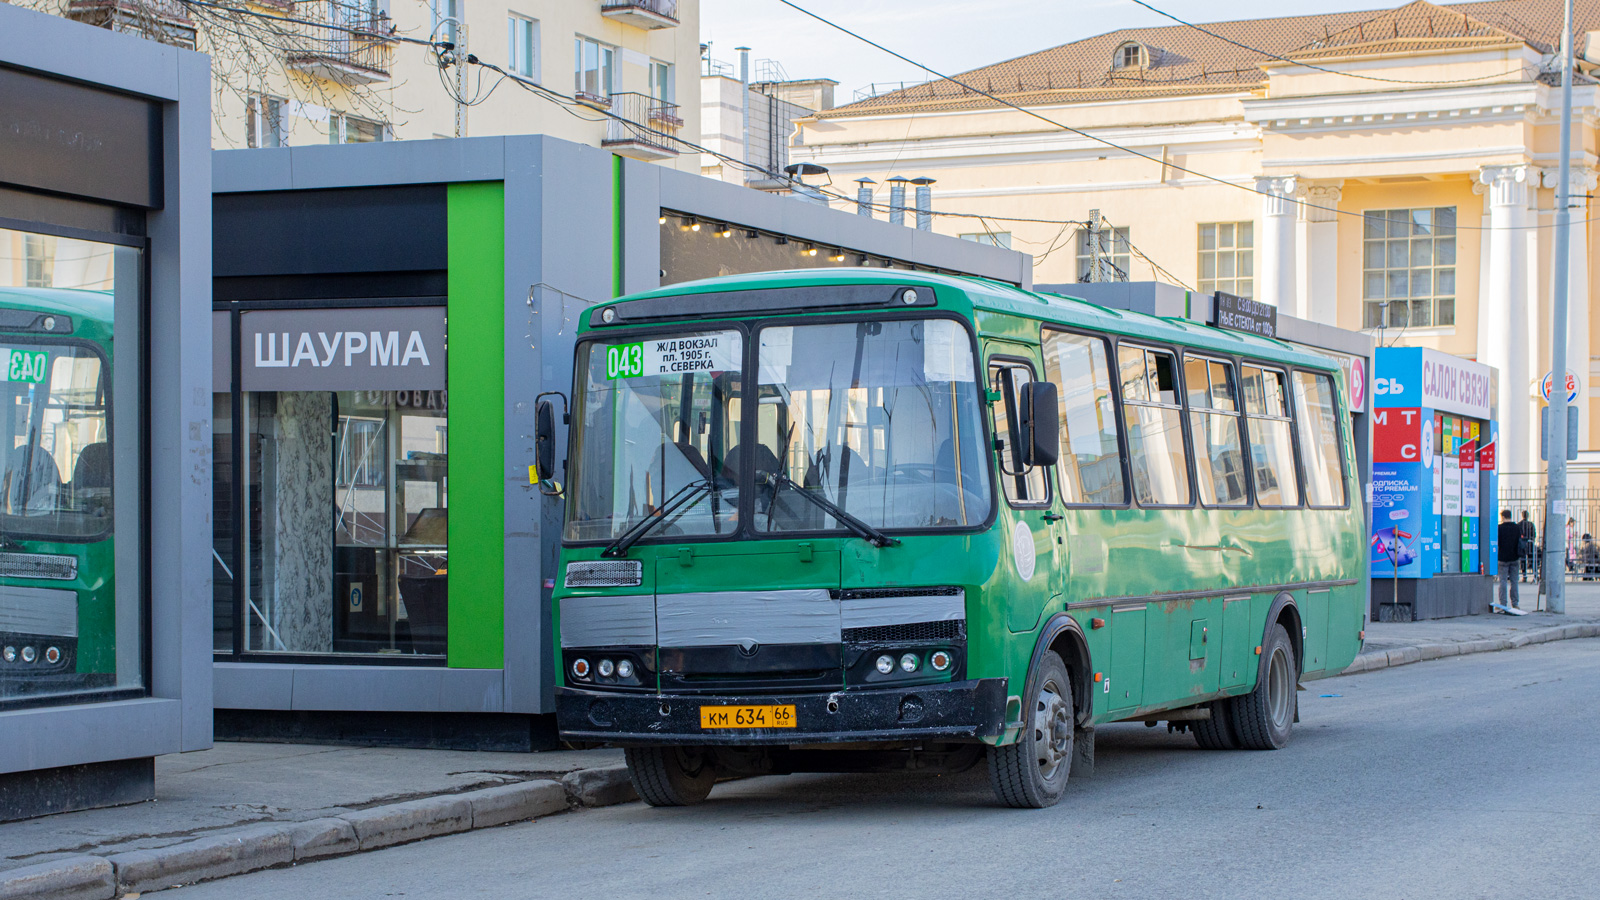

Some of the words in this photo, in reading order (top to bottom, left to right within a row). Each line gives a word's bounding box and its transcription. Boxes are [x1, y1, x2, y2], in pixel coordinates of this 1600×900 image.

[255, 331, 430, 367] ШАУРМА
[656, 342, 677, 353] Ж/Д
[679, 338, 718, 350] ВОКЗАЛ
[608, 345, 642, 378] 043
[662, 354, 678, 362] пл.
[680, 350, 703, 360] 1905
[705, 351, 711, 359] г.
[660, 365, 669, 373] п.
[671, 360, 714, 372] СЕВЕРКА
[1423, 360, 1457, 401] САЛОН
[1460, 369, 1489, 408] СВЯЗИ
[735, 709, 765, 725] 634
[774, 707, 790, 720] 66
